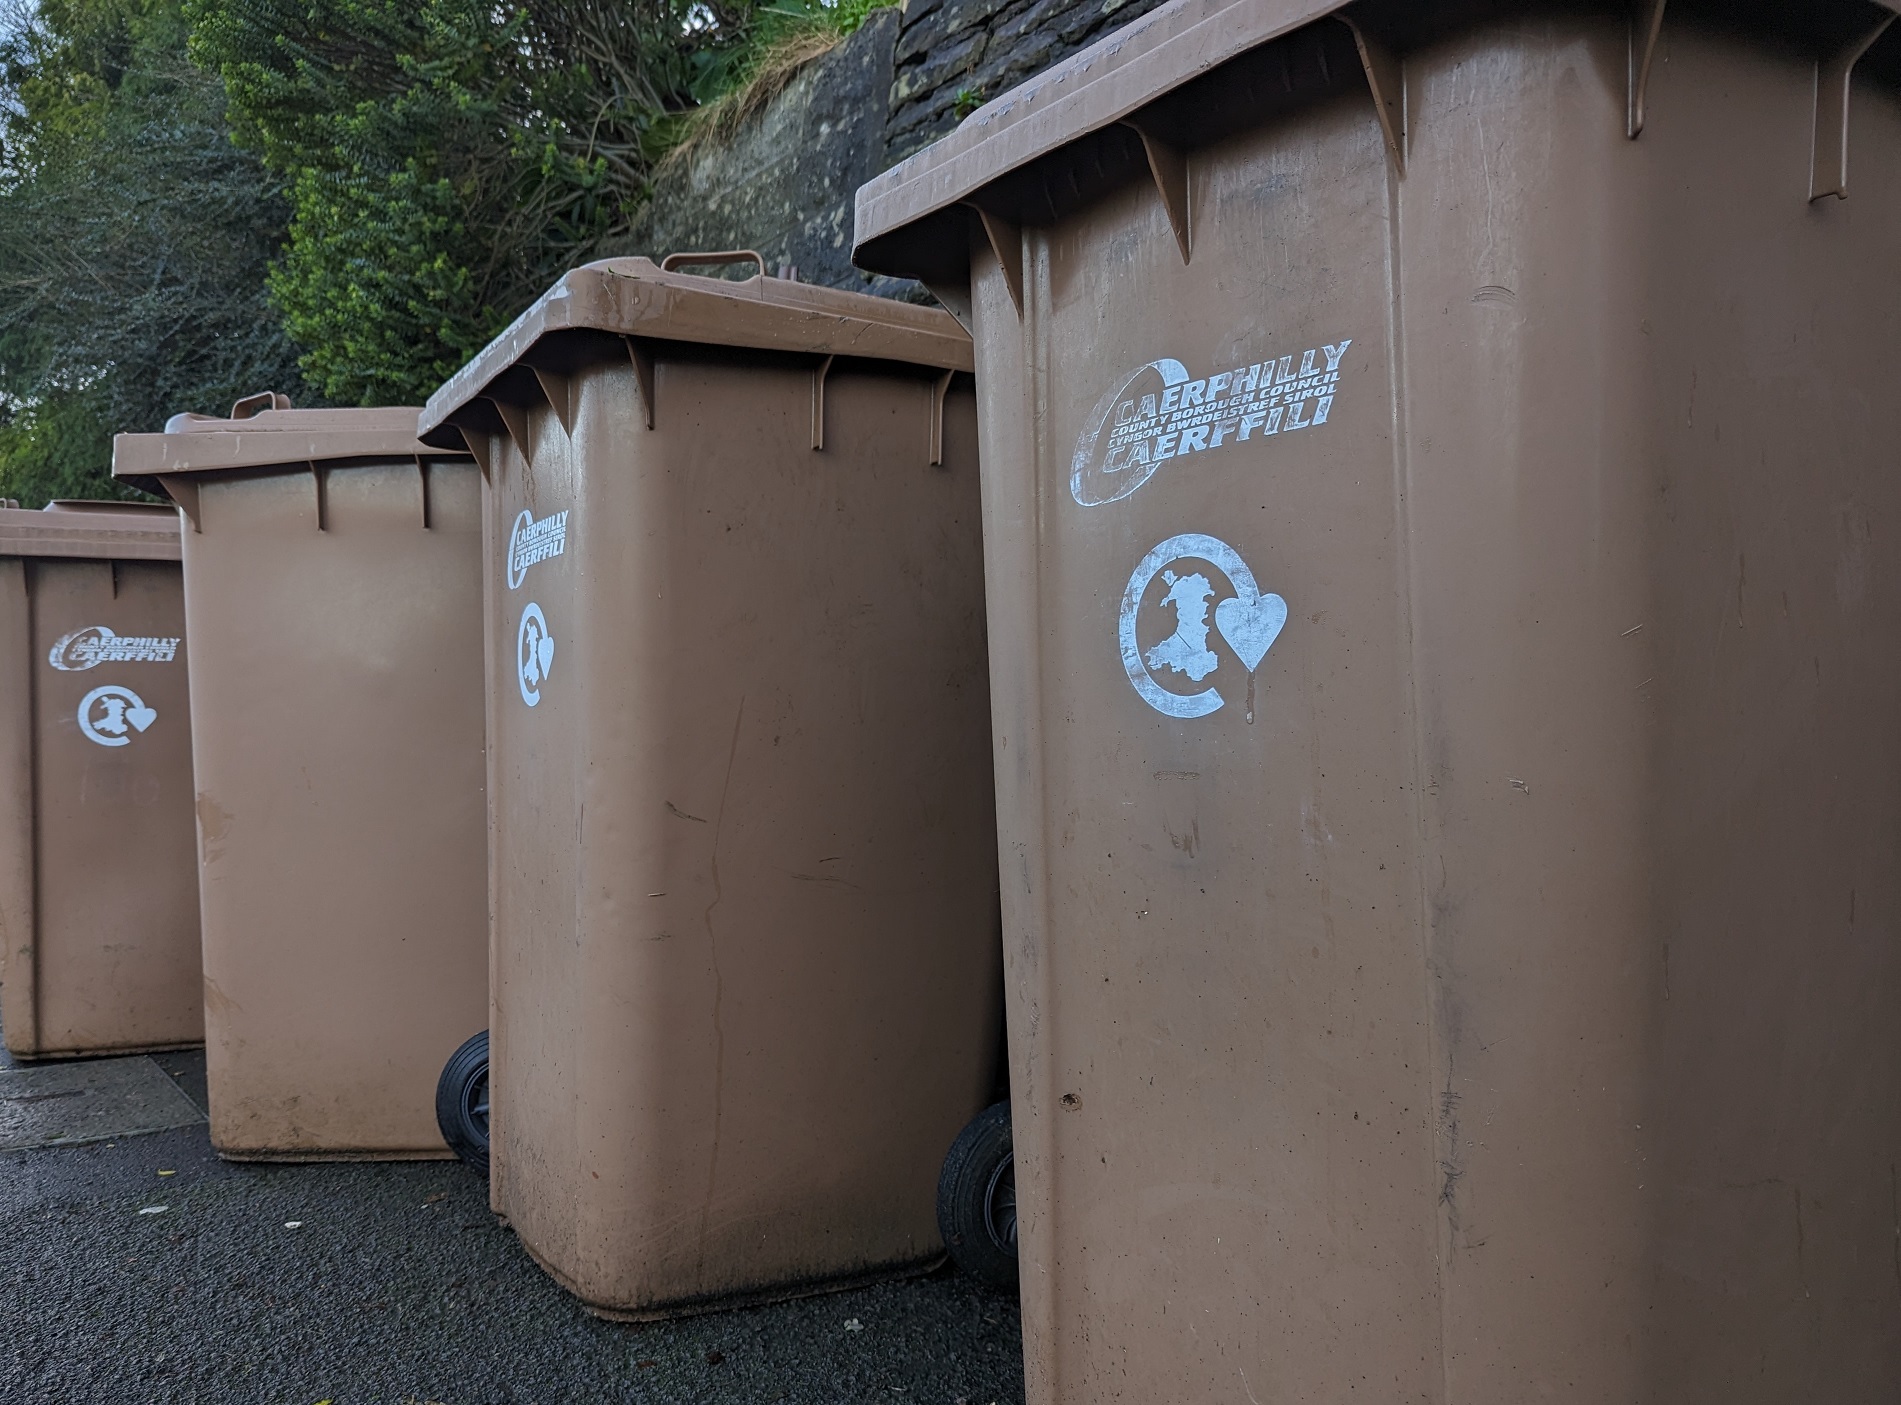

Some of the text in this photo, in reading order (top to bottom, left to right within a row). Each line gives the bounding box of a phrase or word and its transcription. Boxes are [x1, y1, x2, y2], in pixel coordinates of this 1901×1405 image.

[1111, 371, 1341, 437] COUNTY BOROUGH COUNCIL
[1115, 340, 1352, 426] CAERPHILLY
[1103, 395, 1336, 473] CAERFFILI
[1107, 384, 1337, 449] CYNGOR BWRDEISTREF SIROL
[514, 538, 565, 571] CAERFFILI
[516, 509, 569, 546] CAERPHILLY
